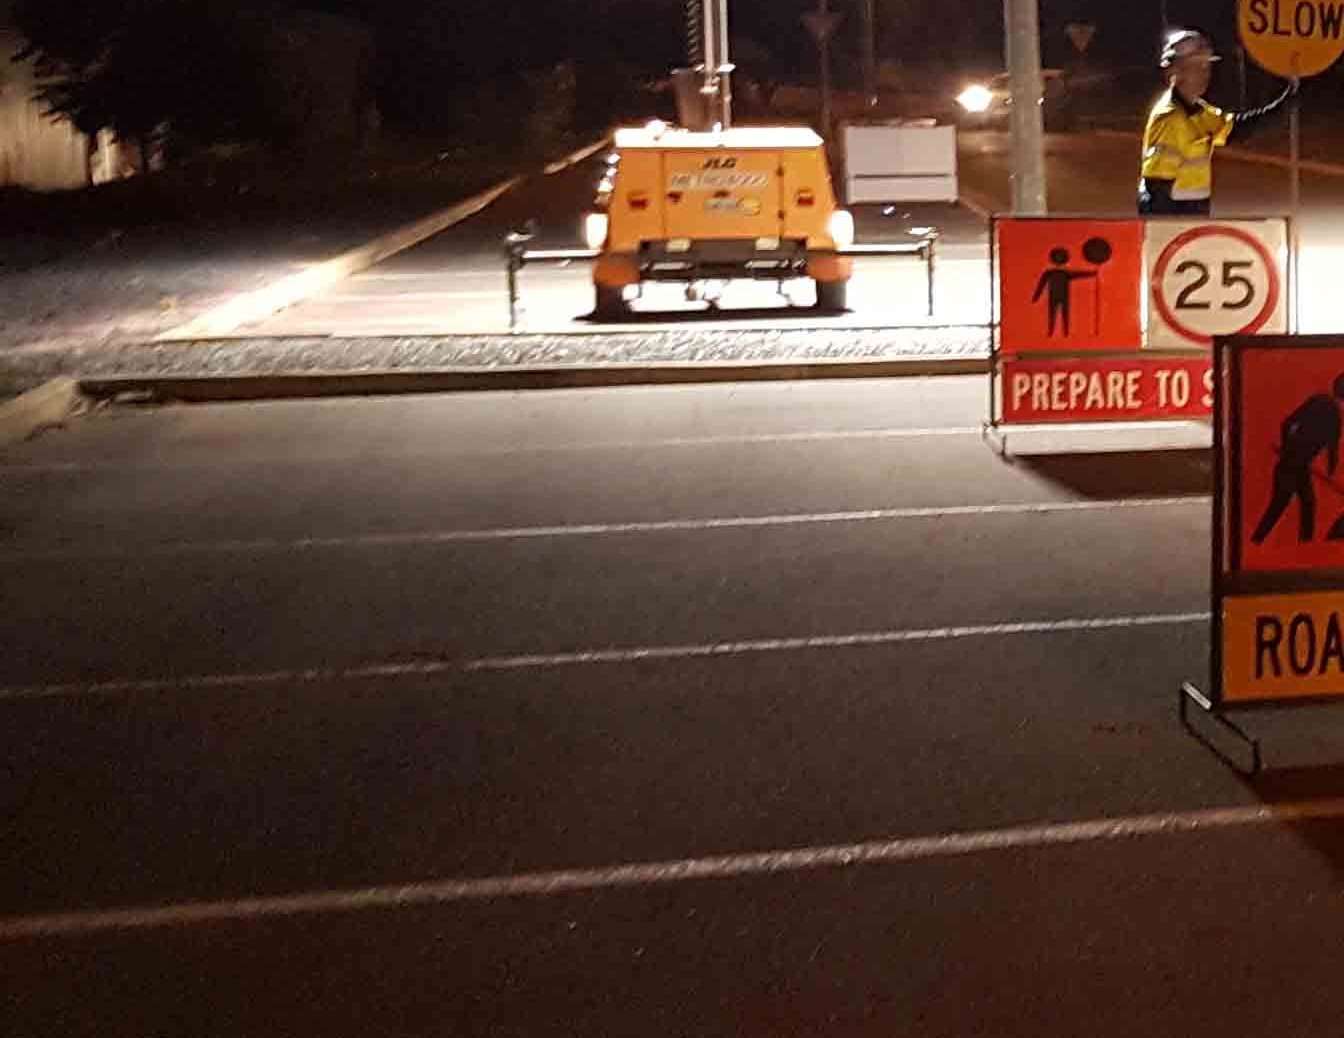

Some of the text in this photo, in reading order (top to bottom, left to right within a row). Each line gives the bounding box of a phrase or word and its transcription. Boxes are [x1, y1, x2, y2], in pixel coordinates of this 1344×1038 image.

[1174, 260, 1255, 310] 25
[1011, 369, 1143, 412] PREPARE
[1154, 369, 1190, 409] TO
